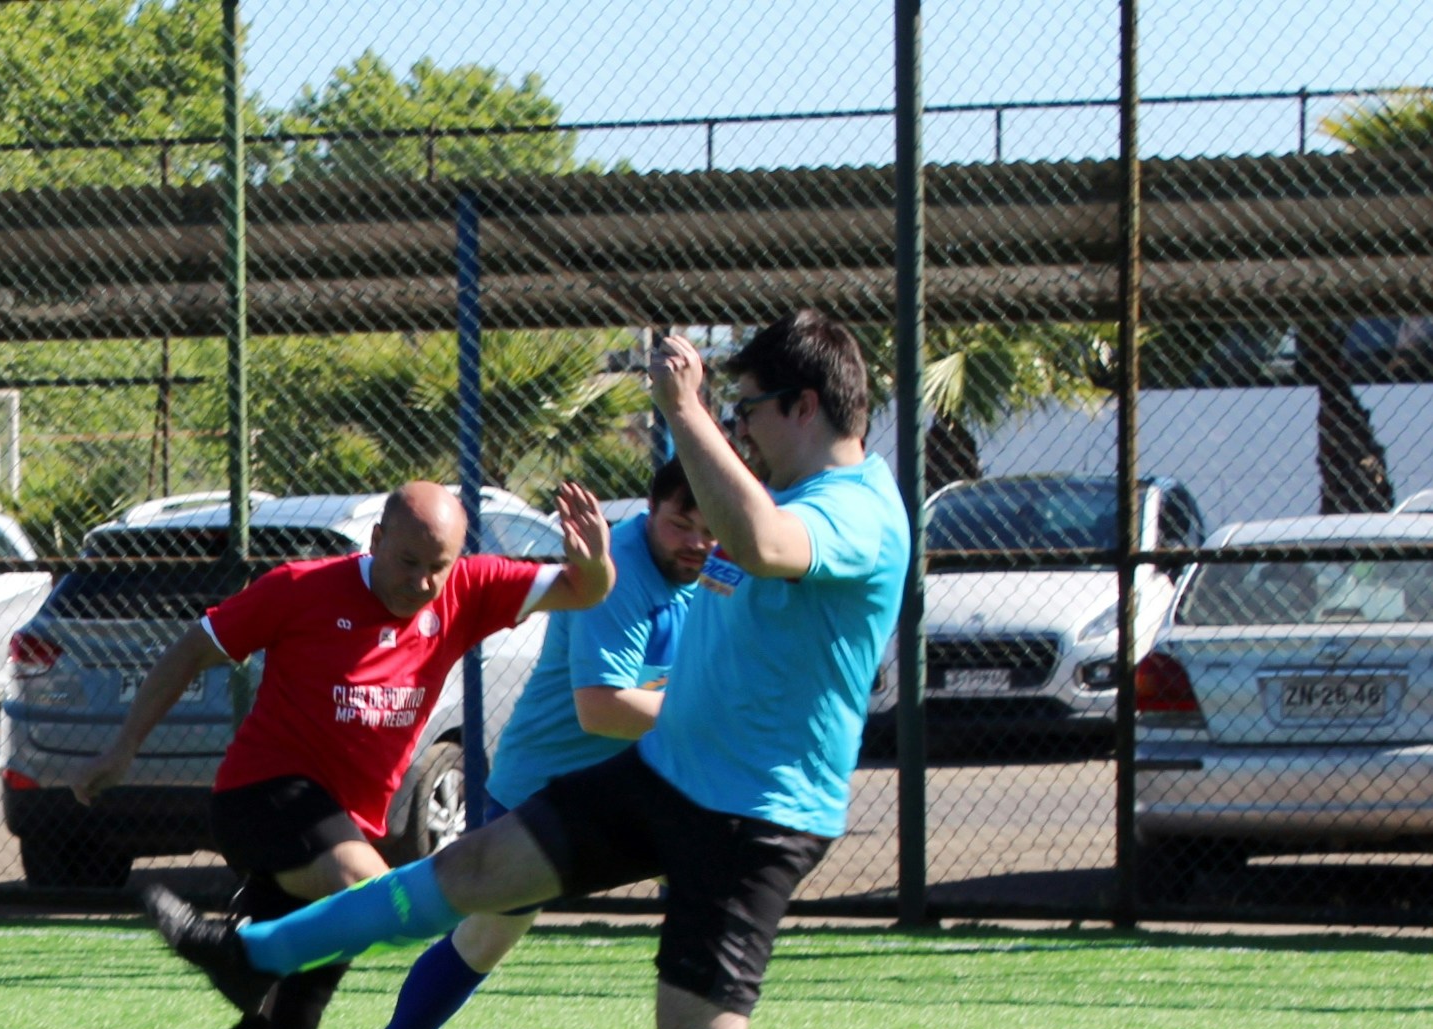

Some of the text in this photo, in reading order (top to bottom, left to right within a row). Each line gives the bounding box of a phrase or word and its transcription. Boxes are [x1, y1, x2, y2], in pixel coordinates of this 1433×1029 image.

[333, 685, 426, 710] CLUB DEPORTIVO
[335, 705, 356, 722] MP
